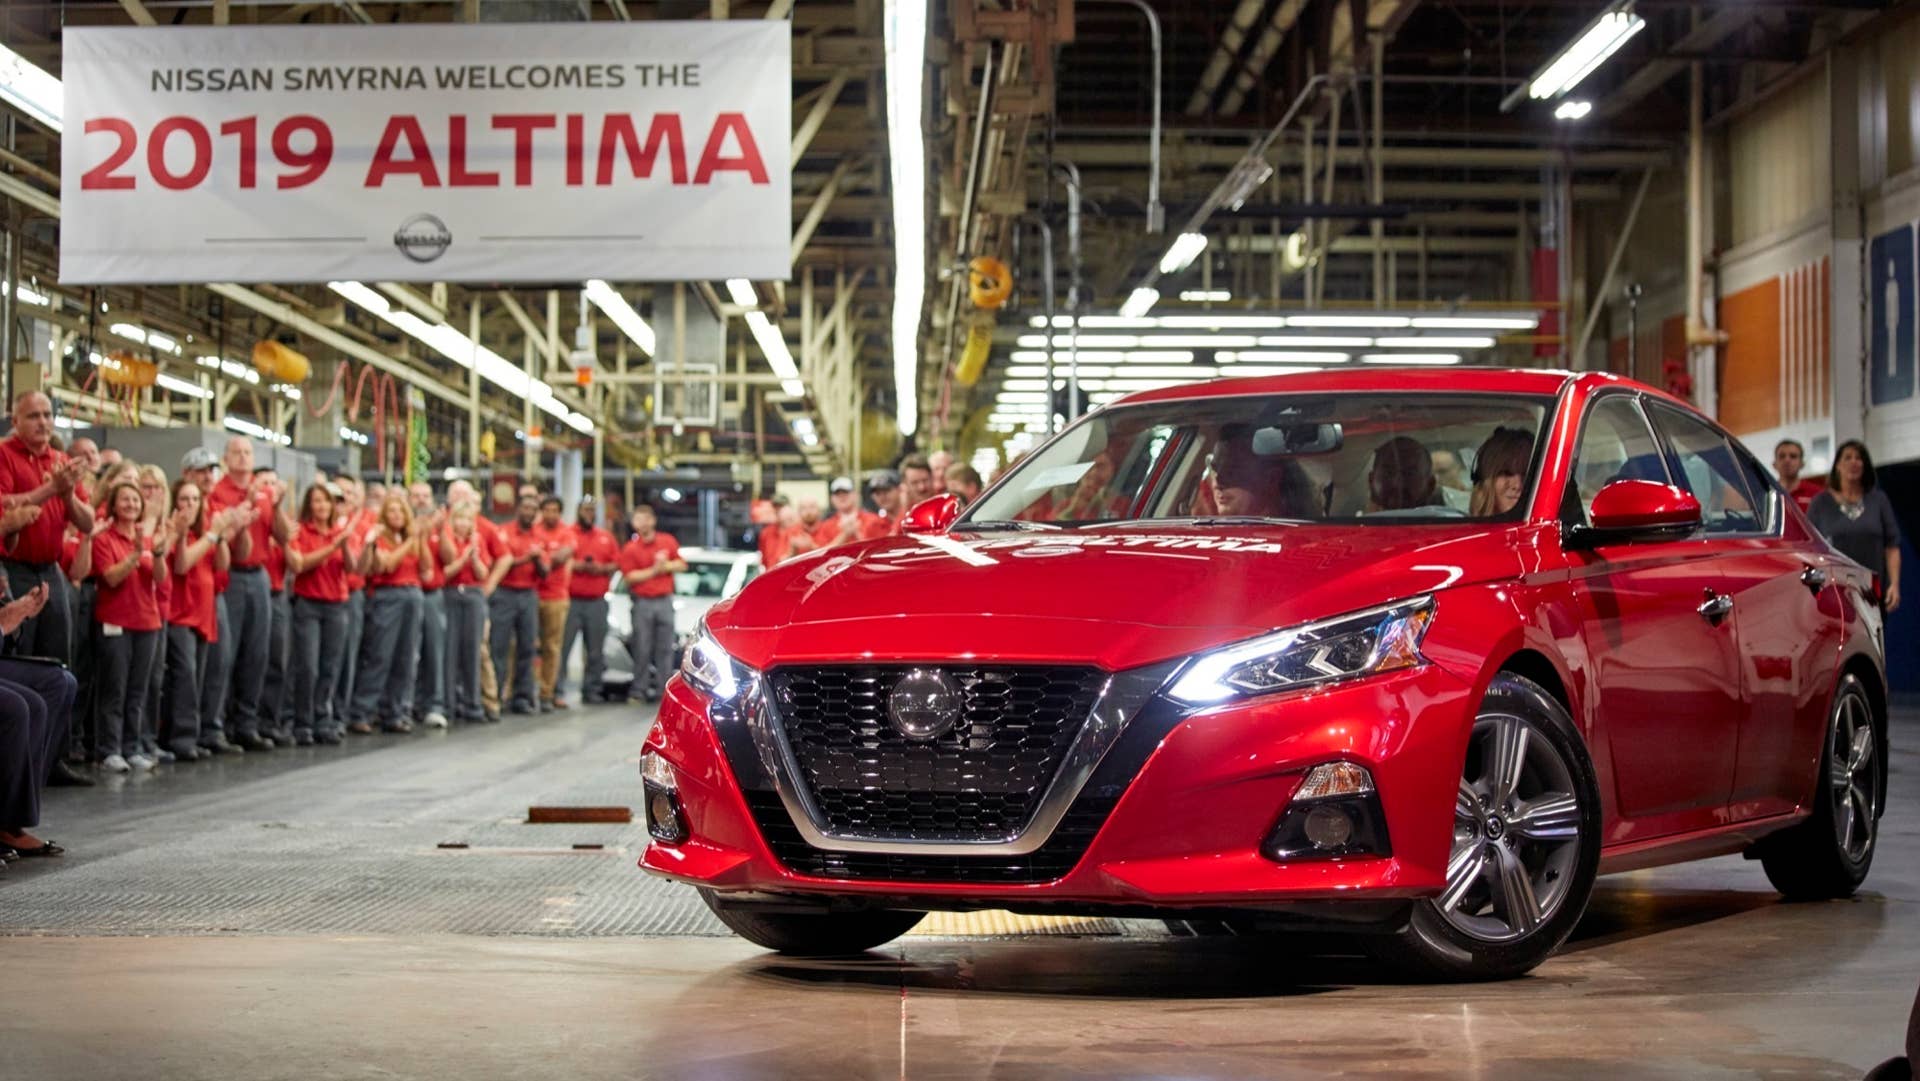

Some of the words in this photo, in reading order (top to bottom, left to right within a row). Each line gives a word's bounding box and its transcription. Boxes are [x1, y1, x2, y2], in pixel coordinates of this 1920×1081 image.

[151, 67, 274, 92] NISSAN
[283, 66, 428, 91] SMYRNA
[434, 64, 626, 90] WELCOMES
[635, 63, 701, 88] THE
[80, 114, 335, 191] 2019
[364, 112, 771, 188] ALTIMA
